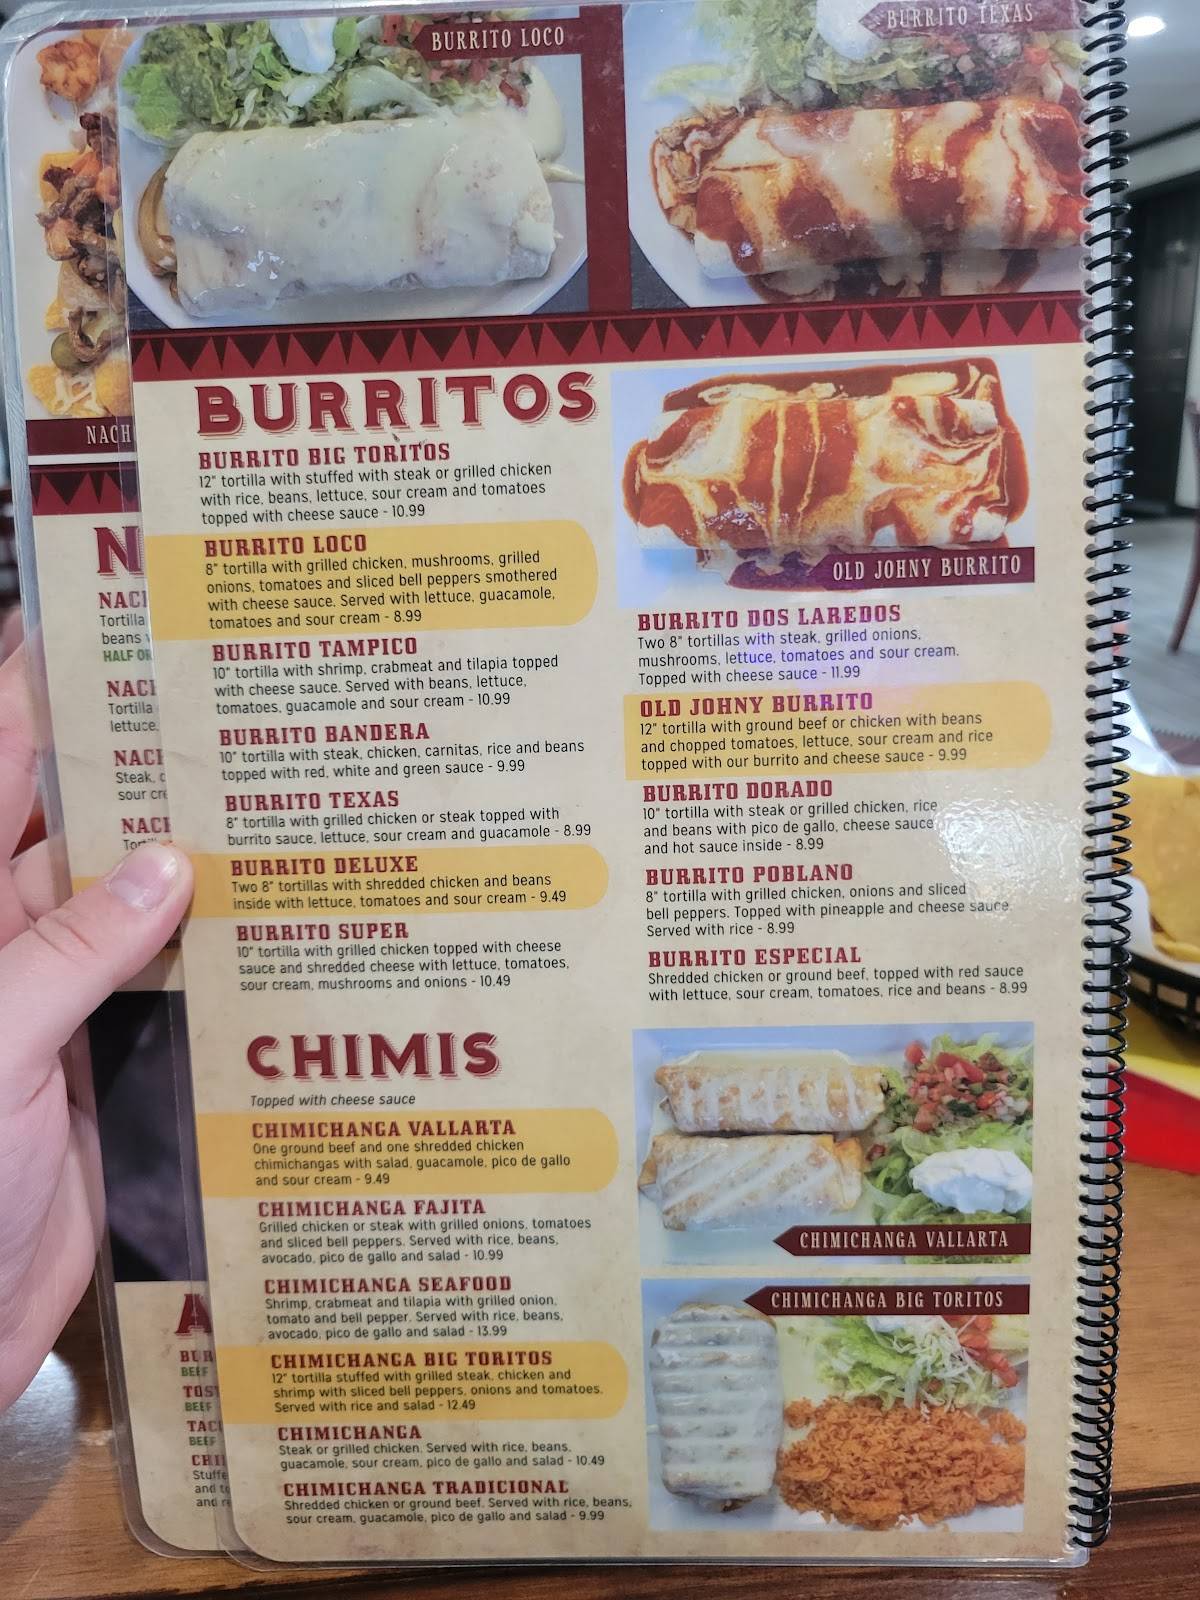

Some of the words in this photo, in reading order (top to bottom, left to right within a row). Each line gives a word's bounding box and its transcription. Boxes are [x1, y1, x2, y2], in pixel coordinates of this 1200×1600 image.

[887, 6, 968, 29] BURRITO
[976, 2, 1034, 25] TEXAS
[432, 28, 511, 51] BURRITO
[521, 26, 564, 47] LOCO
[195, 371, 599, 438] BURRITOS
[198, 448, 299, 470] BURRITO
[308, 446, 345, 466] BIG
[353, 442, 450, 464] TORITOS
[221, 473, 266, 487] tortilla
[270, 472, 301, 485] with
[305, 469, 353, 484] stuffed
[358, 468, 388, 482] with
[393, 466, 431, 481] steak
[435, 468, 449, 479] or
[453, 463, 495, 482] grilled
[500, 462, 551, 477] chicken
[201, 510, 248, 527] topped
[252, 509, 283, 523] with
[287, 508, 335, 522] cheese
[339, 508, 379, 520] sauce
[392, 503, 425, 517] 10.99
[204, 536, 304, 557] BURRITO
[313, 534, 367, 553] LOCO
[833, 561, 864, 581] OLD
[874, 558, 931, 579] JOHNY
[941, 554, 1020, 576] BURRITO
[100, 614, 145, 628] Tortilla
[209, 616, 272, 629] tomatoes
[276, 613, 301, 627] and
[305, 615, 335, 626] sour
[339, 613, 380, 625] cream
[393, 609, 422, 623] 8.99
[637, 610, 738, 631] BURRITO
[747, 608, 788, 627] DOS
[797, 604, 900, 625] LAREDOS
[102, 631, 142, 645] beans
[103, 649, 134, 662] HALF
[212, 641, 310, 661] BURRITO
[318, 637, 417, 658] TAMPICO
[108, 702, 153, 716] Tortilla
[640, 699, 681, 717] OLD
[689, 696, 763, 716] JOHNY
[771, 692, 872, 713] BURRITO
[218, 726, 316, 746] BURRITO
[324, 722, 430, 742] BANDERA
[662, 720, 706, 735] tortilla
[710, 719, 741, 733] with
[745, 717, 793, 735] ground
[798, 715, 827, 730] beef
[831, 718, 845, 729] or
[850, 714, 901, 728] chicken
[906, 713, 936, 726] with
[941, 713, 982, 725] beans
[641, 756, 687, 773] topped
[691, 755, 722, 769] with
[726, 757, 749, 768] our
[753, 753, 799, 767] burrito
[803, 752, 828, 765] and
[832, 751, 880, 764] cheese
[885, 751, 924, 763] sauce
[938, 747, 967, 761] 9.99
[224, 792, 320, 812] BURRITO
[328, 790, 399, 809] TEXAS
[642, 782, 738, 802] BURRITO
[745, 779, 832, 799] DORADO
[242, 815, 285, 828] tortilla
[289, 814, 319, 827] with
[323, 812, 363, 830] grilled
[367, 811, 417, 825] chicken
[421, 813, 435, 824] or
[439, 809, 475, 823] steak
[479, 807, 525, 824] topped
[529, 807, 559, 820] with
[644, 841, 668, 855] and
[673, 841, 694, 854] hot
[699, 842, 738, 853] sauce
[742, 838, 782, 851] inside
[795, 837, 824, 850] 8.99
[230, 857, 325, 876] BURRITO
[333, 855, 418, 874] DELUXE
[645, 866, 744, 886] BURRITO
[752, 863, 852, 883] POBLANO
[231, 881, 258, 893] Two
[278, 879, 328, 892] tortillas
[332, 878, 361, 891] with
[366, 876, 425, 890] shredded
[430, 875, 479, 889] chicken
[483, 874, 507, 887] and
[512, 873, 551, 886] beans
[236, 923, 330, 941] BURRITO
[338, 922, 408, 940] SUPER
[257, 945, 300, 957] tortilla
[303, 944, 332, 957] with
[336, 943, 376, 959] grilled
[380, 942, 429, 956] chicken
[433, 941, 478, 957] topped
[482, 940, 511, 953] with
[516, 939, 561, 953] cheese
[648, 949, 746, 967] BURRITO
[754, 946, 861, 965] ESPECIAL
[247, 1032, 501, 1080] CHIMIS
[250, 1094, 295, 1109] Topped
[298, 1094, 327, 1106] with
[330, 1094, 375, 1106] cheese
[378, 1095, 416, 1105] sauce
[252, 1121, 401, 1138] CHIMICHANGA
[408, 1119, 516, 1136] VALLARTA
[253, 1142, 276, 1154] One
[280, 1142, 324, 1157] ground
[328, 1140, 355, 1153] beef
[359, 1140, 382, 1153] and
[386, 1143, 410, 1152] one
[414, 1139, 472, 1152] shredded
[476, 1139, 524, 1151] chicken
[258, 1200, 406, 1217] CHIMICHANGA
[413, 1199, 486, 1215] FAJITA
[799, 1231, 916, 1248] CHIMICHANGA
[926, 1230, 1008, 1248] VALLARTA
[264, 1277, 411, 1294] CHIMICHANGA
[418, 1276, 511, 1292] SEAFOOD
[771, 1291, 887, 1308] CHIMICHANGA
[895, 1291, 924, 1308] BIG
[932, 1290, 1003, 1307] TORITOS
[270, 1352, 416, 1369] CHIMICHANGA
[423, 1351, 457, 1367] BIG
[464, 1350, 552, 1366] TORITOS
[274, 1401, 315, 1413] Served
[318, 1400, 347, 1412] with
[350, 1400, 373, 1411] rice
[376, 1400, 399, 1411] and
[403, 1399, 435, 1411] salad
[447, 1399, 476, 1410] 12.49
[277, 1425, 422, 1441] CHIMICHANGA
[283, 1481, 426, 1497] CHIMICHANGA
[432, 1479, 569, 1494] TRADICIONAL
